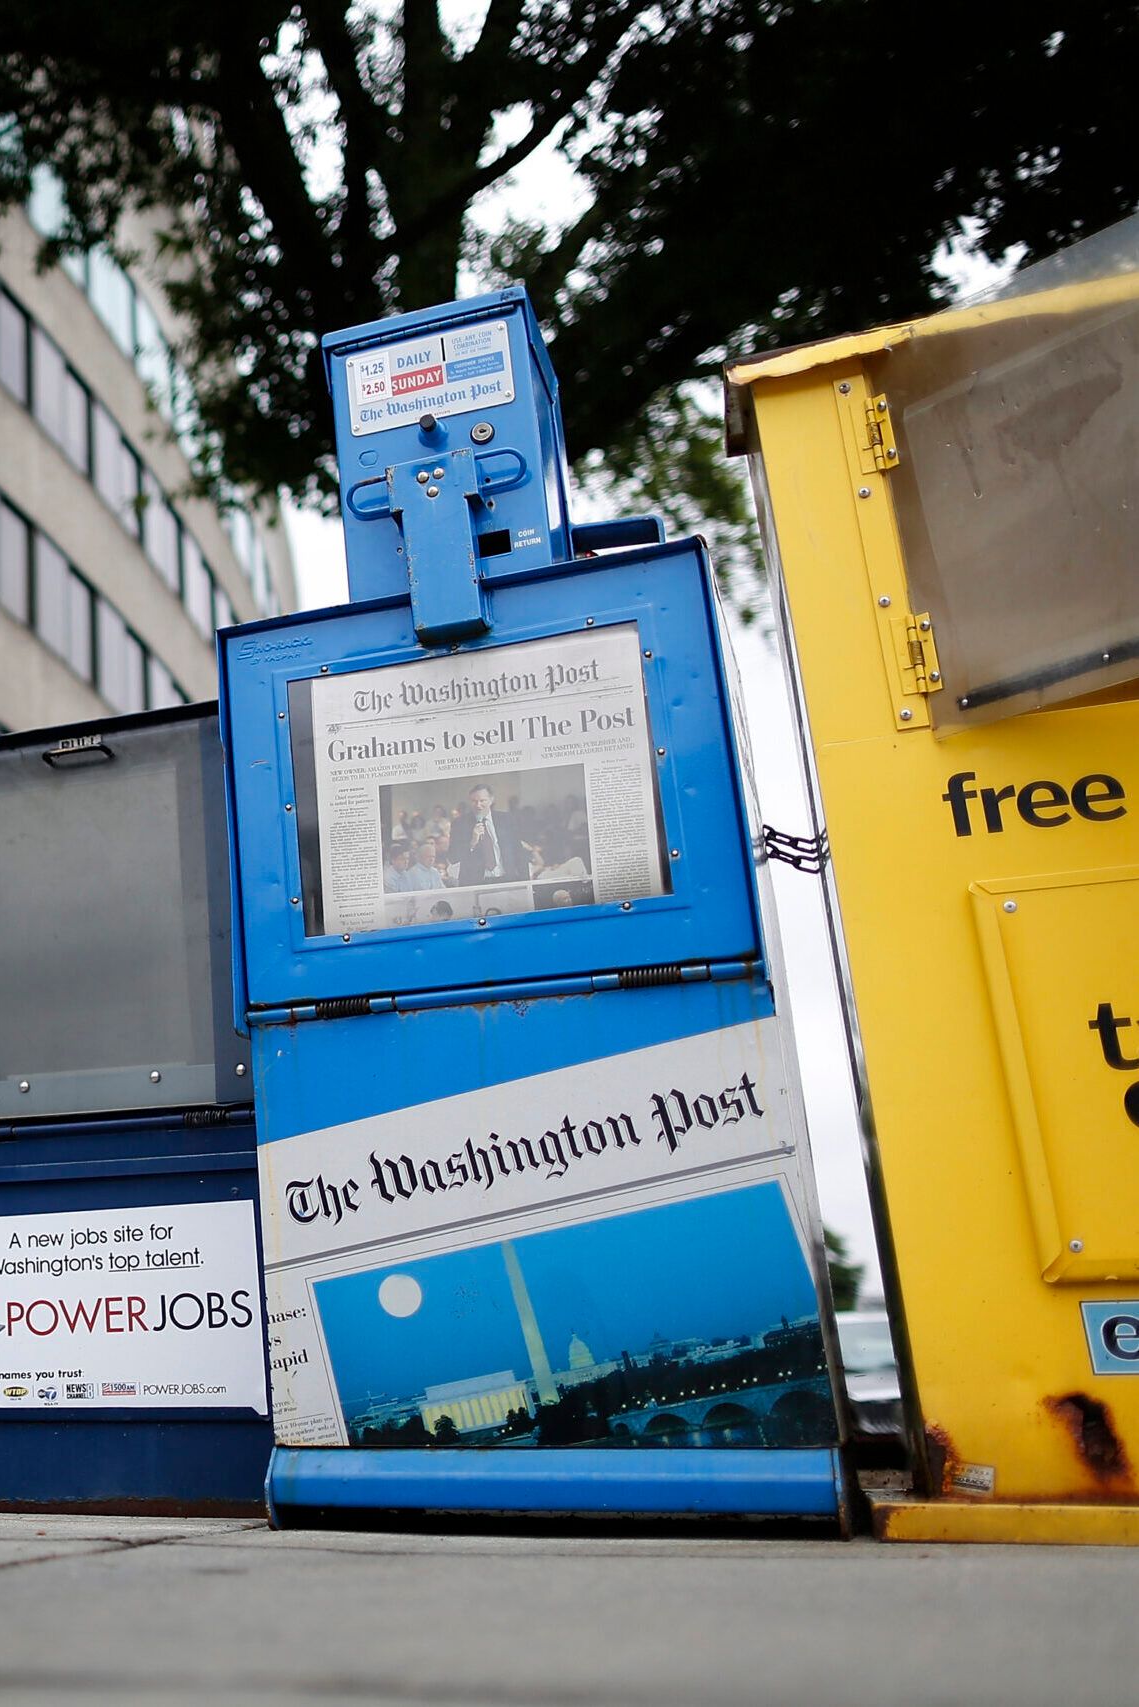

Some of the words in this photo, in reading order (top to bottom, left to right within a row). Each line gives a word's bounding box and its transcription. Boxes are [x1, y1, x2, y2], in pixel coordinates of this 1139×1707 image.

[361, 362, 384, 376] $1.25
[397, 350, 432, 369] DAILY
[362, 381, 385, 395] $2.50
[392, 370, 441, 392] SUNDAY
[360, 407, 383, 422] The
[386, 388, 466, 416] Washington
[470, 380, 502, 401] Post
[514, 537, 541, 549] RETURN
[518, 529, 535, 538] COIN
[353, 689, 393, 715] The
[399, 672, 539, 704] Washington
[544, 659, 600, 695] Post
[327, 736, 436, 763] Grahams
[443, 731, 466, 750] to
[473, 719, 515, 747] sell
[521, 715, 572, 740] The
[579, 707, 636, 733] Post
[941, 771, 1128, 838] free
[286, 1174, 360, 1226] The
[368, 1112, 642, 1204] Washington
[649, 1072, 765, 1156] Post
[9, 1232, 22, 1249] A
[28, 1232, 64, 1248] new
[69, 1228, 108, 1249] jobs
[113, 1226, 144, 1244] site
[149, 1223, 173, 1241] for
[109, 1252, 140, 1272] top
[146, 1247, 204, 1268] talent.
[270, 1349, 309, 1372] apid
[35, 1371, 55, 1381] you
[4, 1387, 28, 1397] WTOP
[66, 1383, 87, 1393] NEWS
[143, 1383, 227, 1396] POWERJOBS.com
